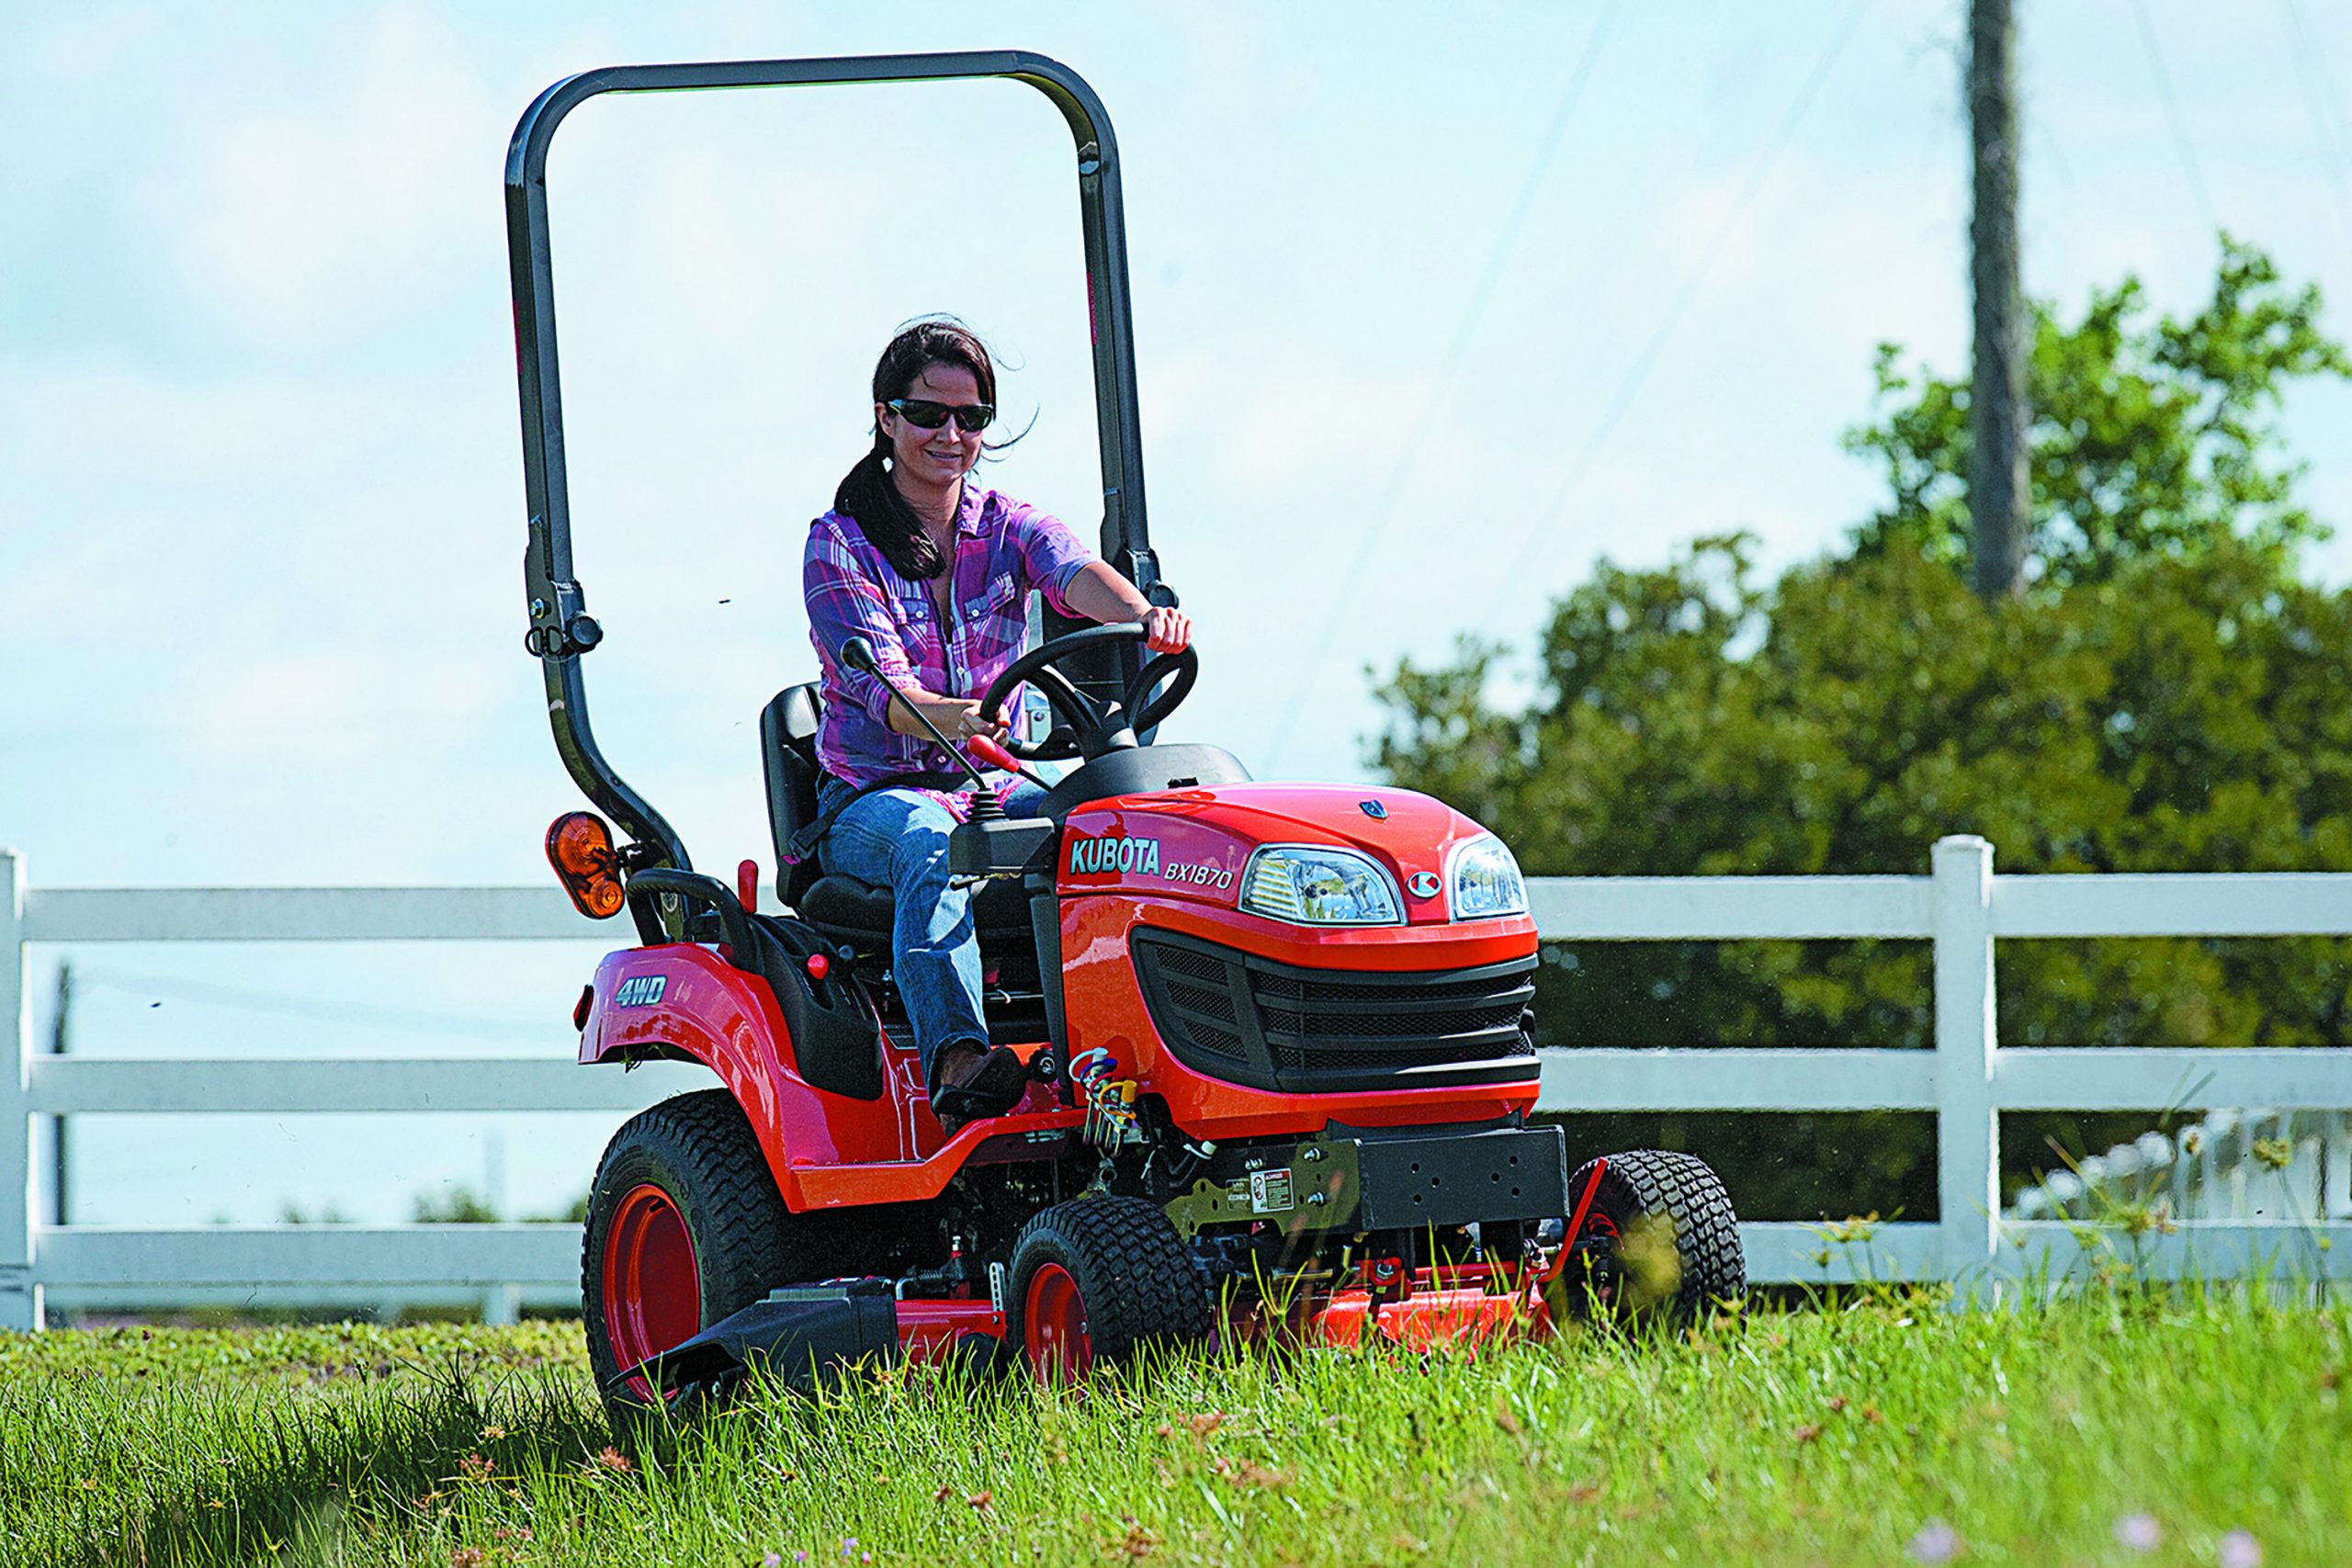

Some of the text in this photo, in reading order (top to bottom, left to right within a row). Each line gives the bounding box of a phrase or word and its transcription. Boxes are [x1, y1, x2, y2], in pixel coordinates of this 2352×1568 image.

[1069, 836, 1233, 890] KUBOTA BX1870
[615, 976, 667, 1008] 4WD
